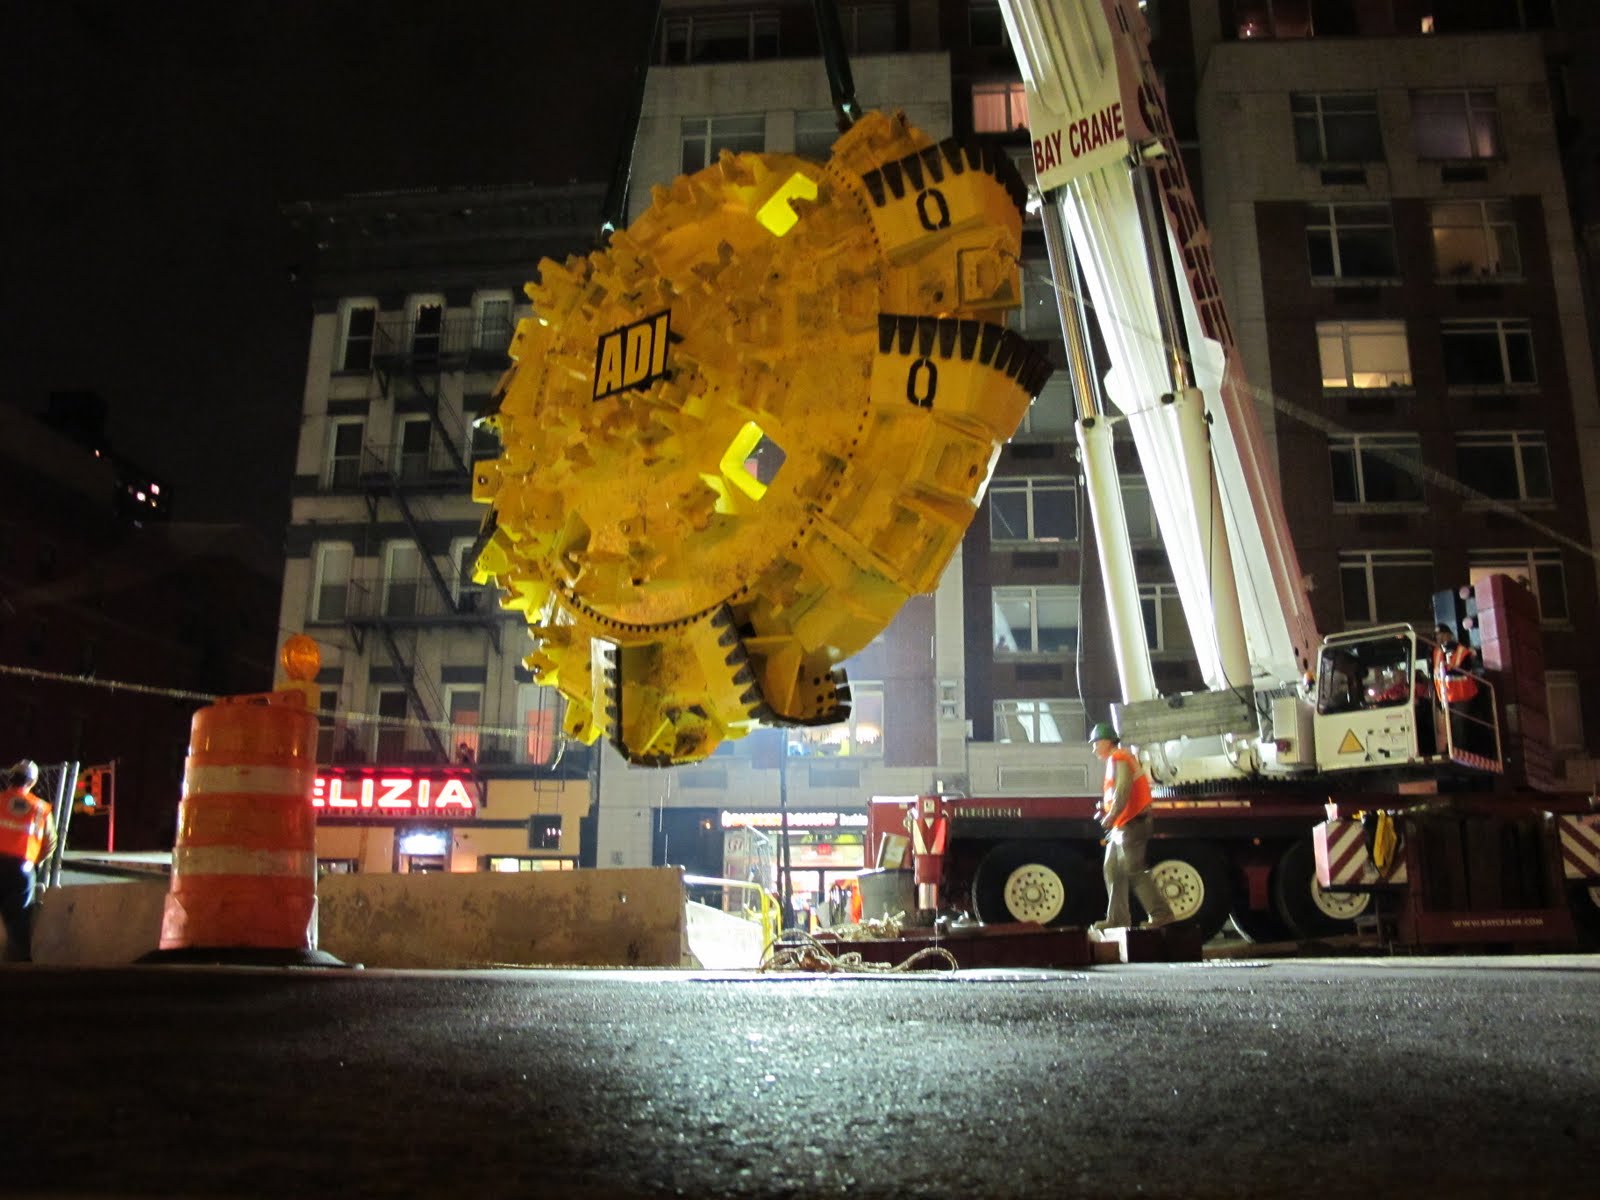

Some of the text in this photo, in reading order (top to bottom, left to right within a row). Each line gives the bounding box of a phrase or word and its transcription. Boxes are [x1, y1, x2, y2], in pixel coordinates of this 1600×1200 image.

[1033, 103, 1125, 174] BAY CRANE
[595, 314, 668, 398] ADI
